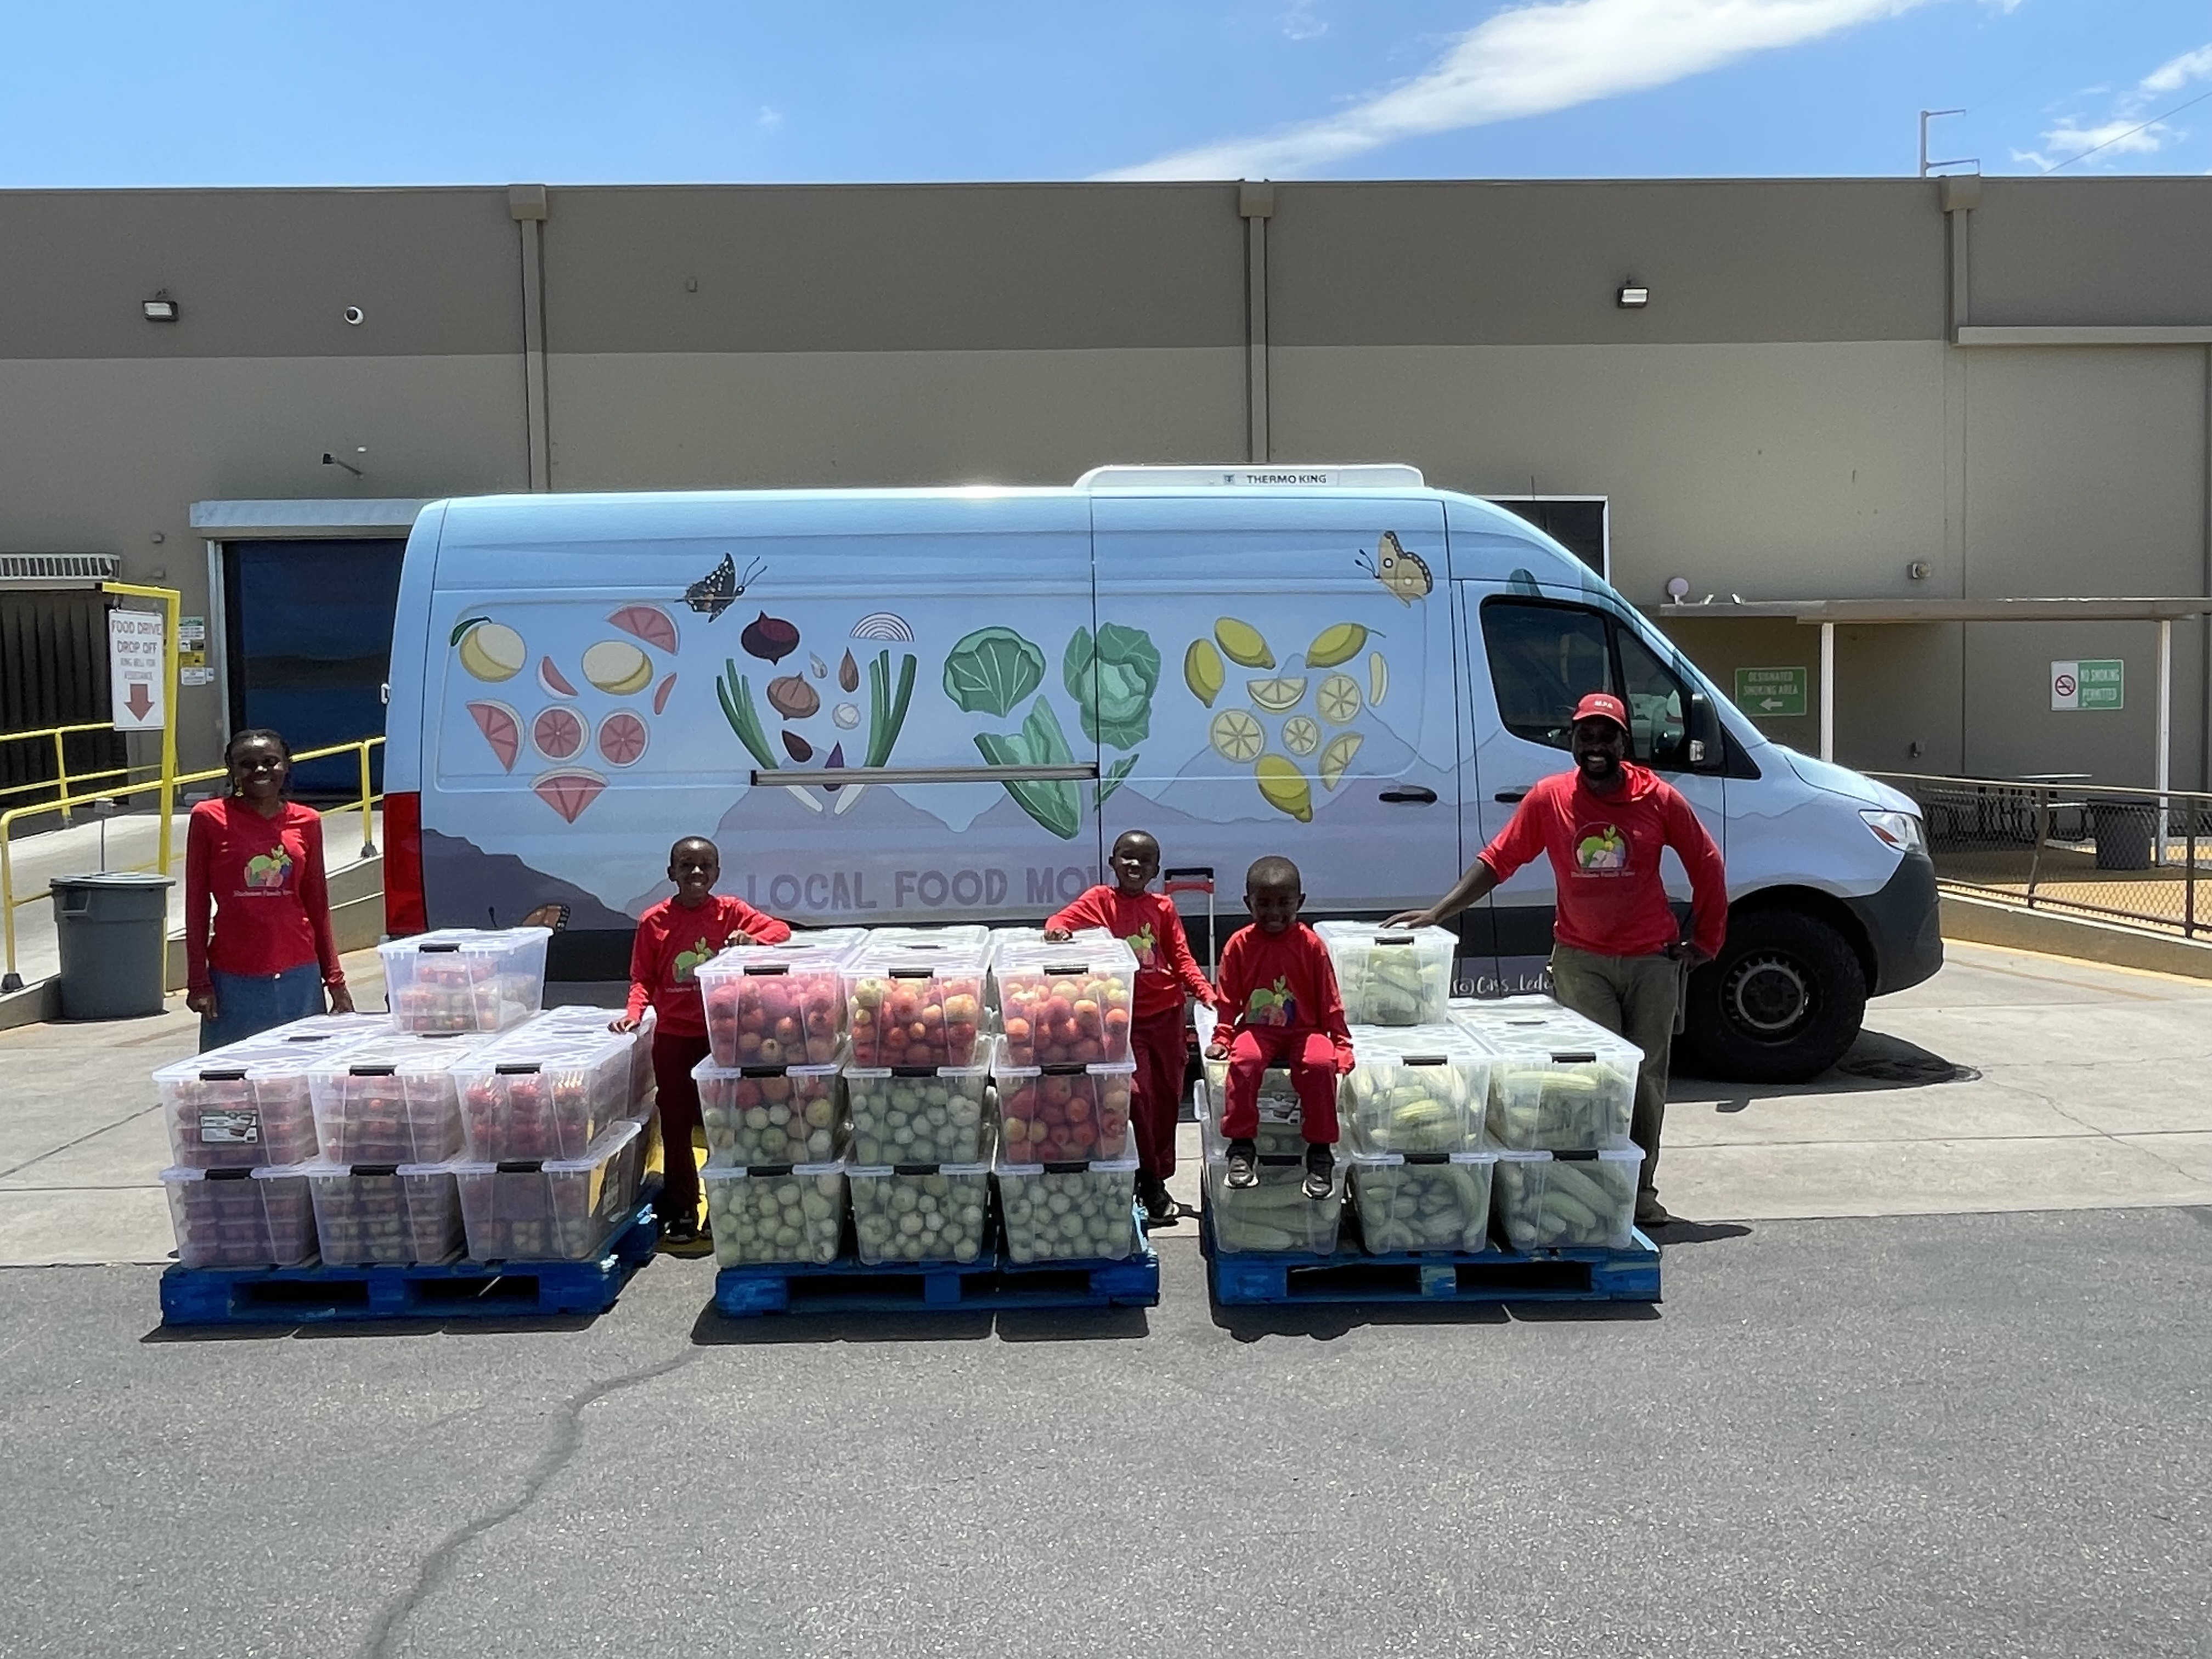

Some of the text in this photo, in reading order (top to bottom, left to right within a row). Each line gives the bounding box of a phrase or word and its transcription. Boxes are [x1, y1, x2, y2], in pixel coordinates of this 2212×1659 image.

[1246, 474, 1327, 484] THERMO KING
[111, 620, 162, 635] FOOD DRIVE
[117, 640, 158, 654] DROP OFF
[1748, 672, 1793, 682] DESIGNATED
[2091, 668, 2120, 682] SMOKING
[1743, 684, 1798, 696] SMOKING AREA
[748, 872, 878, 911] LOCAL
[894, 868, 1008, 908] FOOD
